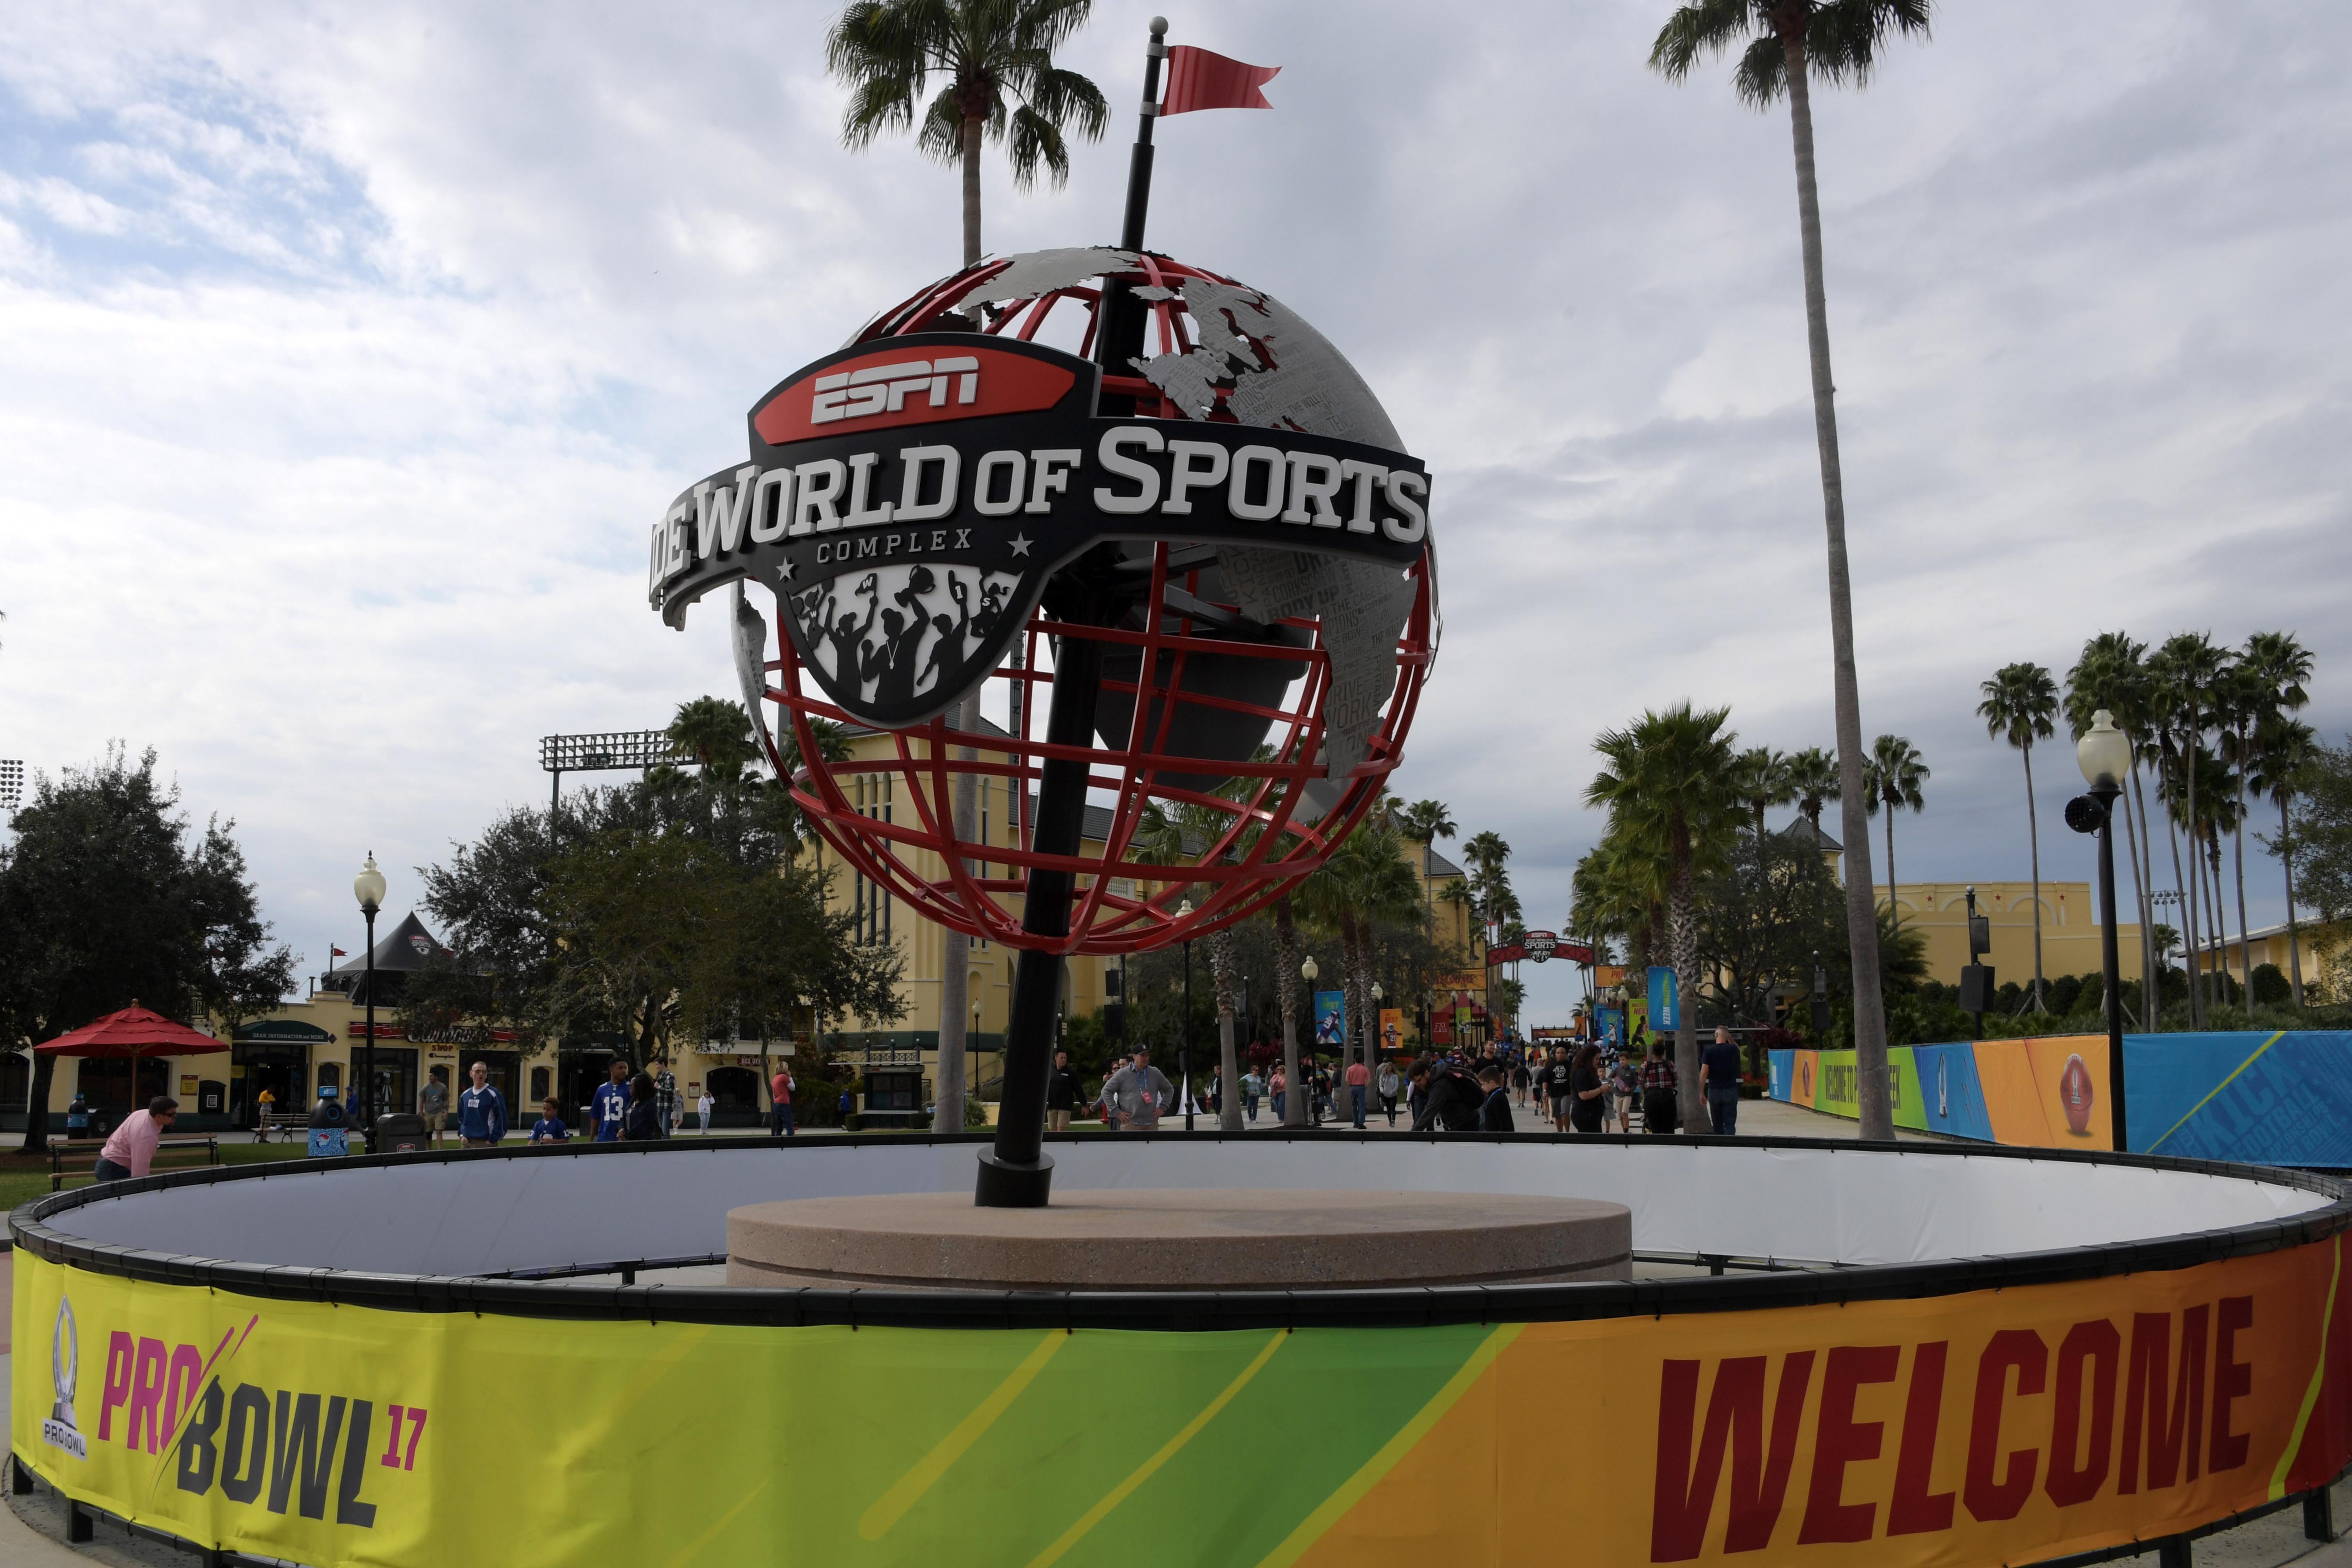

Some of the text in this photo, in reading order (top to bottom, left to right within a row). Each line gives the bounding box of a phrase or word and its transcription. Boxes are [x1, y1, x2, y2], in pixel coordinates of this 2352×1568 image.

[811, 356, 979, 425] ESPN
[694, 444, 961, 559] WORLD
[974, 449, 1081, 515] OF
[1094, 426, 1427, 543] SPORTS
[816, 528, 971, 563] COMPLEX
[1317, 584, 1340, 605] UP
[1524, 941, 1556, 949] SPORTS
[1663, 1006, 1671, 1025] WEEK
[1825, 1065, 1846, 1103] WELCOME
[603, 1096, 624, 1122] 13
[98, 1330, 204, 1455] PRO
[44, 1422, 64, 1444] PRO
[1650, 1294, 2253, 1563] WELCOME
[177, 1374, 428, 1529] BOWL 17
